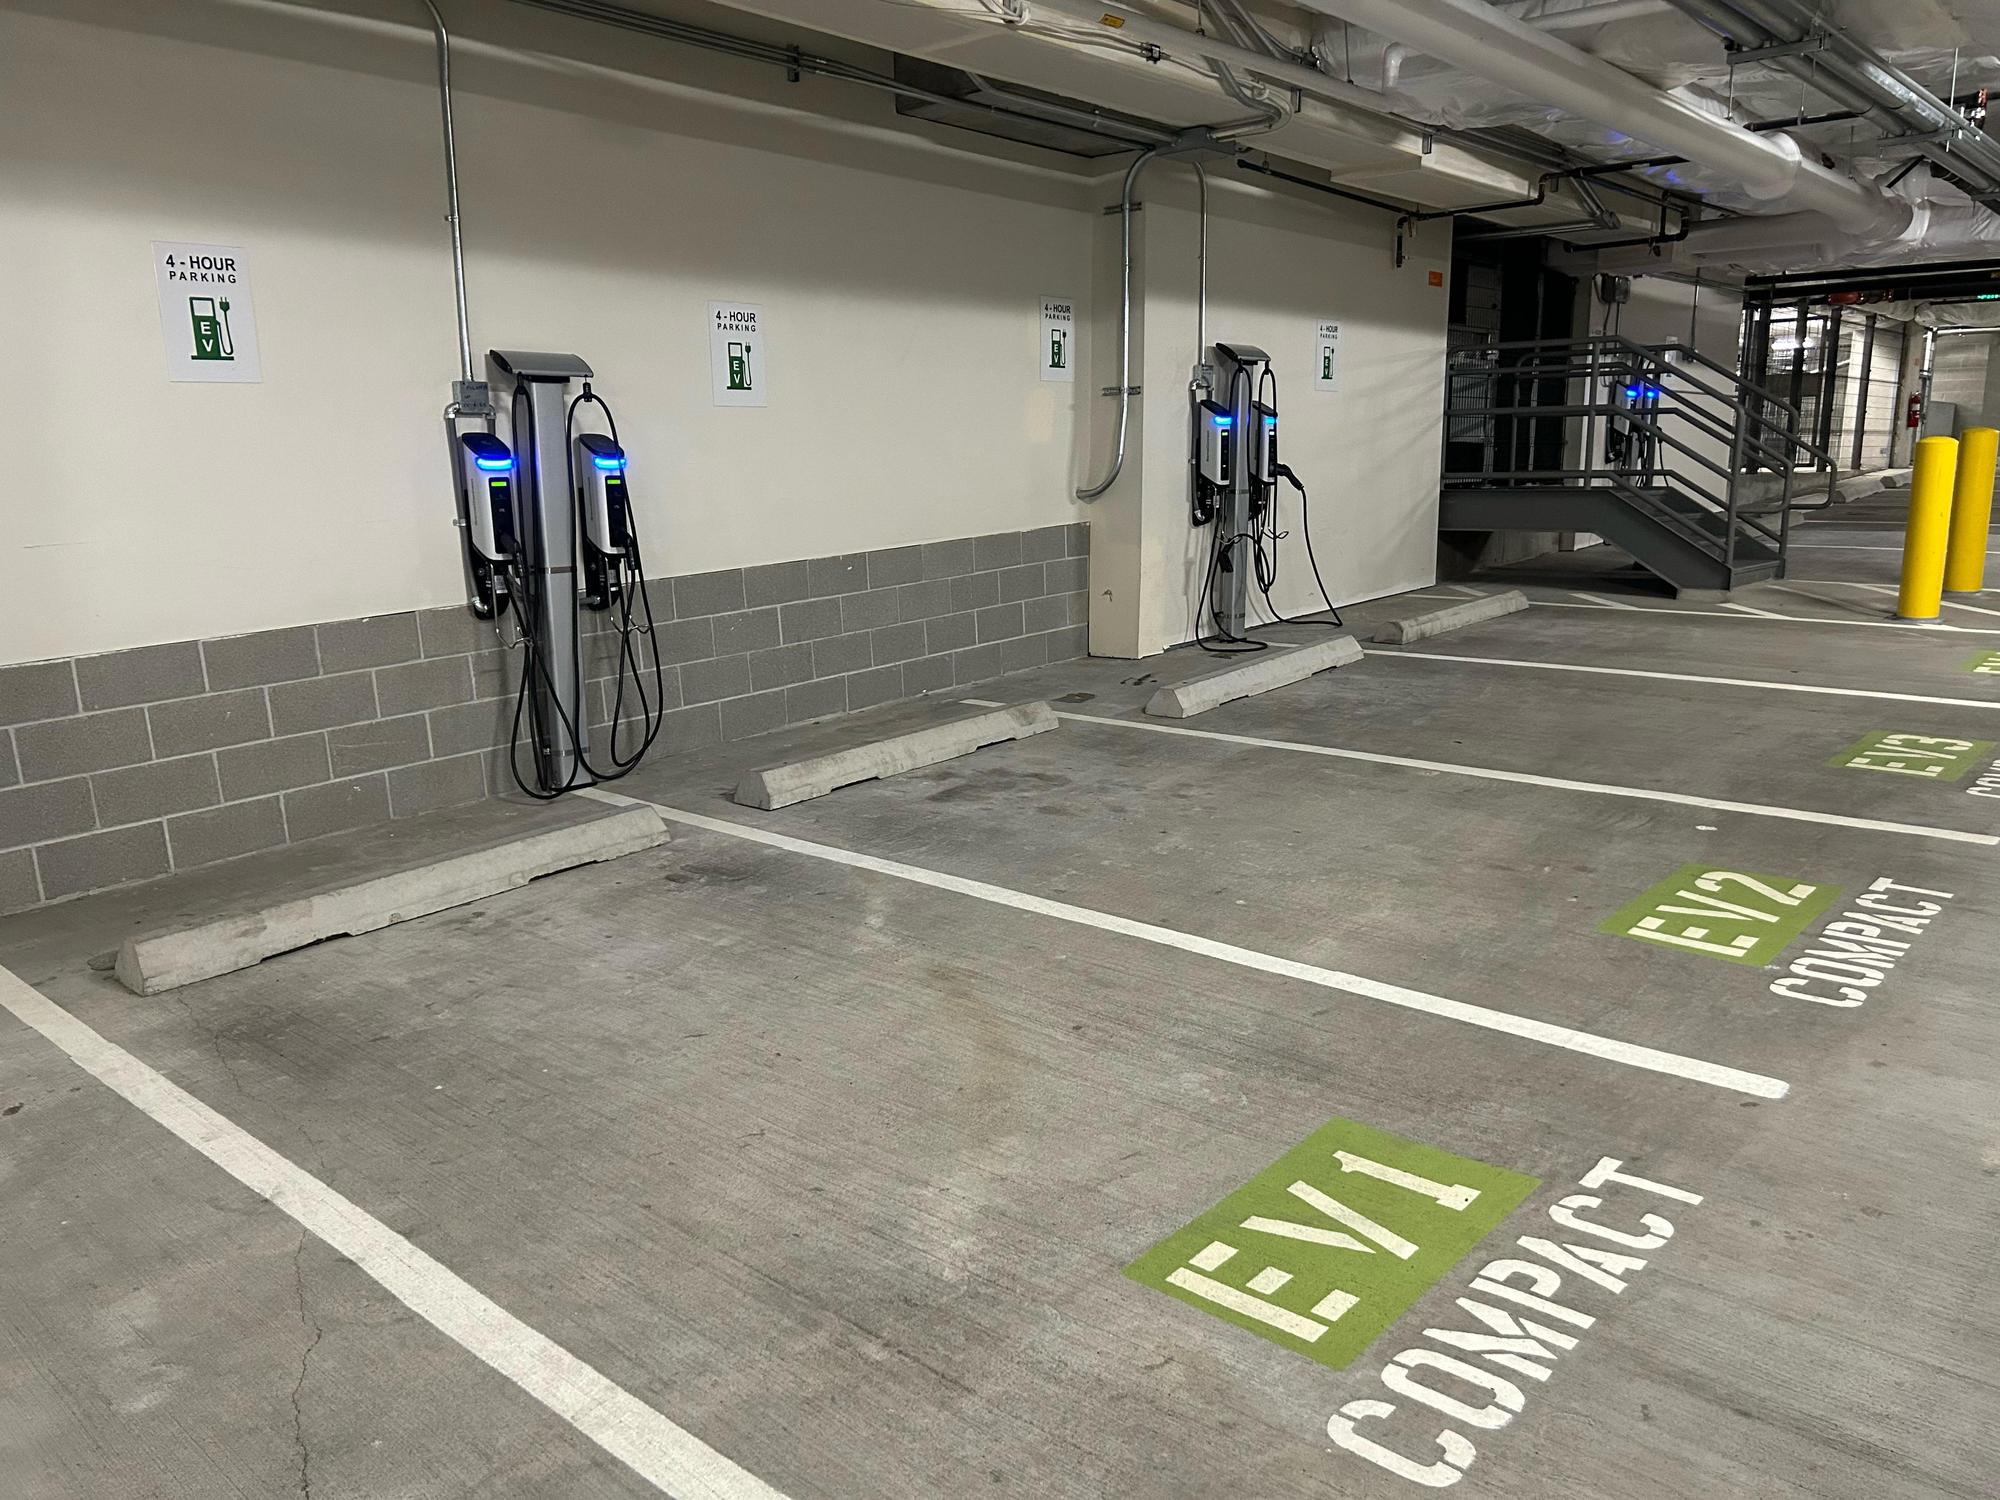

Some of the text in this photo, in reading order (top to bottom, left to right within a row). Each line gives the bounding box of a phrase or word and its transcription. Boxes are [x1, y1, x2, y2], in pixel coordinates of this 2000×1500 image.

[169, 271, 236, 283] PARKING
[200, 321, 213, 352] EV
[717, 323, 756, 332] PARKING
[1045, 313, 1071, 321] PARKING
[1845, 734, 1973, 777] EV3
[1627, 871, 1816, 957] EV2
[1769, 876, 1954, 1008] COMPACT
[1166, 1150, 1482, 1343] EV1
[1326, 1156, 1704, 1488] COMPACT
